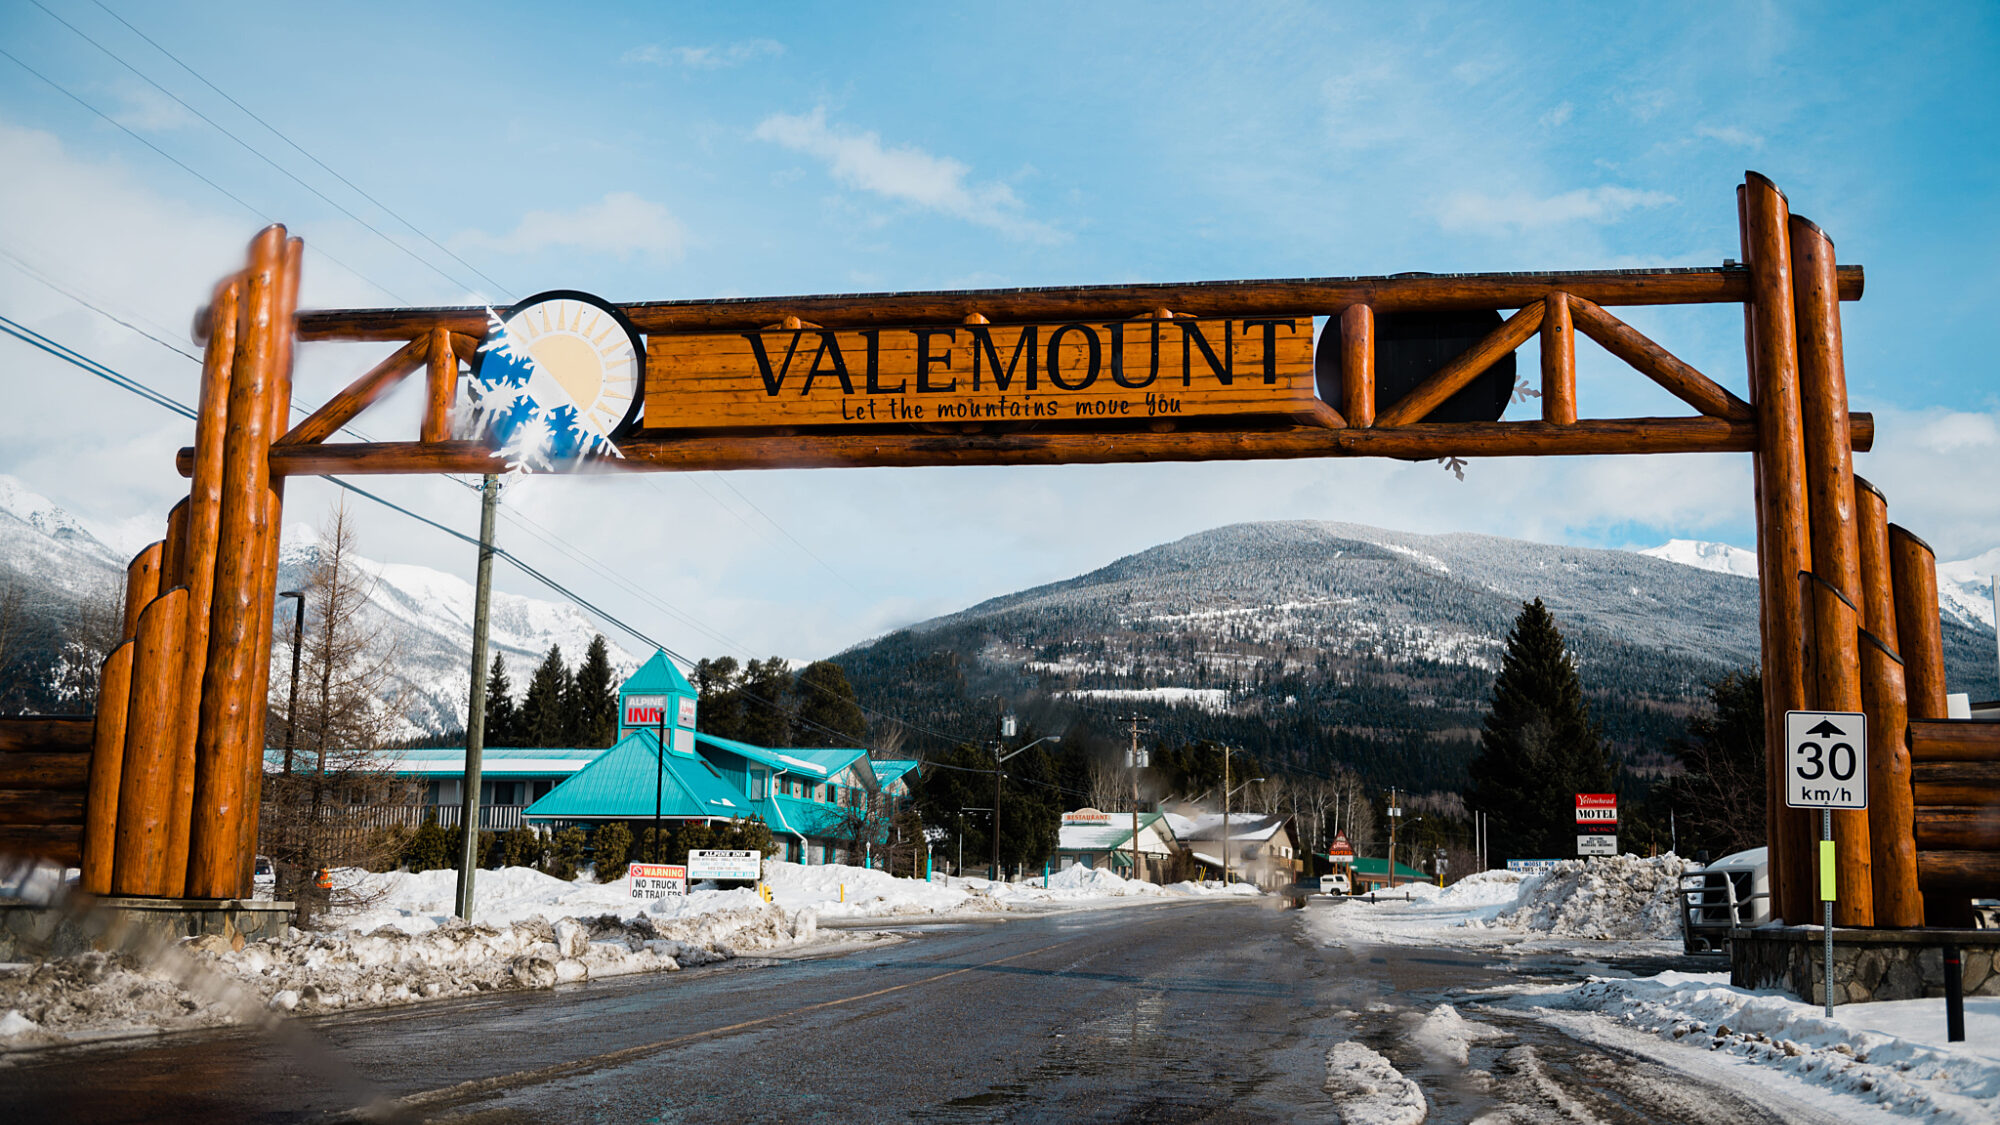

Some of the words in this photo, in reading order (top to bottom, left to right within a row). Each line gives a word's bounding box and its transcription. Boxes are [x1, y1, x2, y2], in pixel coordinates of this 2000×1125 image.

[741, 319, 1296, 396] VALEMOUNT
[842, 397, 876, 420] Let
[888, 397, 924, 420] the
[937, 395, 1058, 419] mountains
[1076, 399, 1130, 415] move
[628, 697, 664, 706] ALPINE
[628, 707, 664, 723] INN
[1796, 742, 1857, 781] 30
[1802, 786, 1852, 802] km/h
[1578, 795, 1615, 805] Yellowhead
[1578, 809, 1616, 819] MOTEL
[643, 867, 683, 878] WARNING
[635, 879, 647, 888] NO
[651, 880, 677, 889] TRUCK
[632, 889, 643, 898] OR
